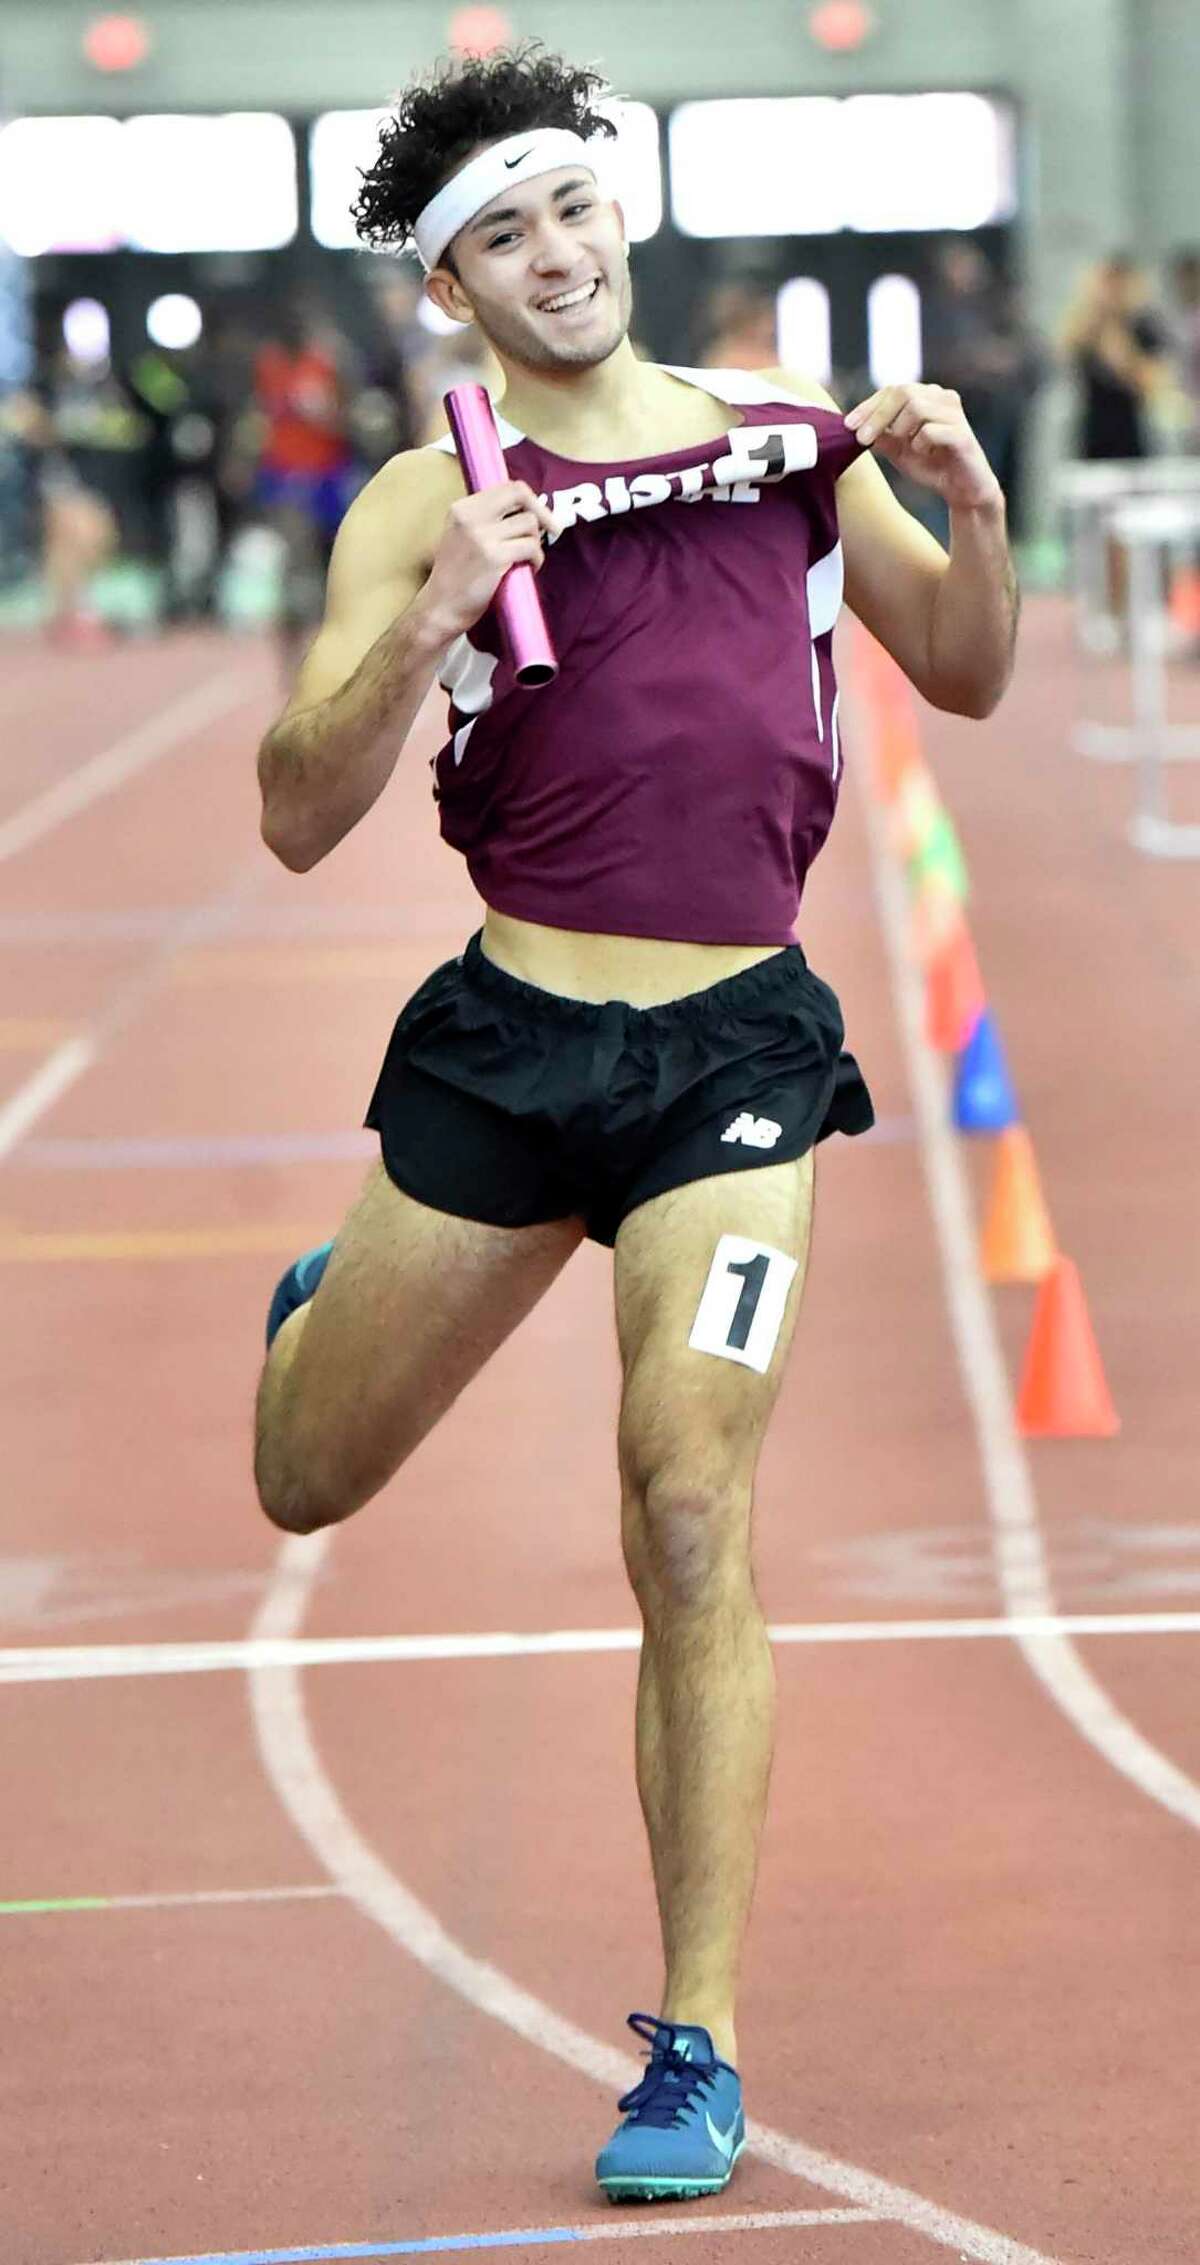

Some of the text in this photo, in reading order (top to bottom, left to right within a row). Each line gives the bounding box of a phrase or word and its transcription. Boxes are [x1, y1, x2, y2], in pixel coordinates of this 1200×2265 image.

[748, 434, 785, 477] 1
[720, 1112, 782, 1149] NB
[726, 1253, 770, 1350] 1
